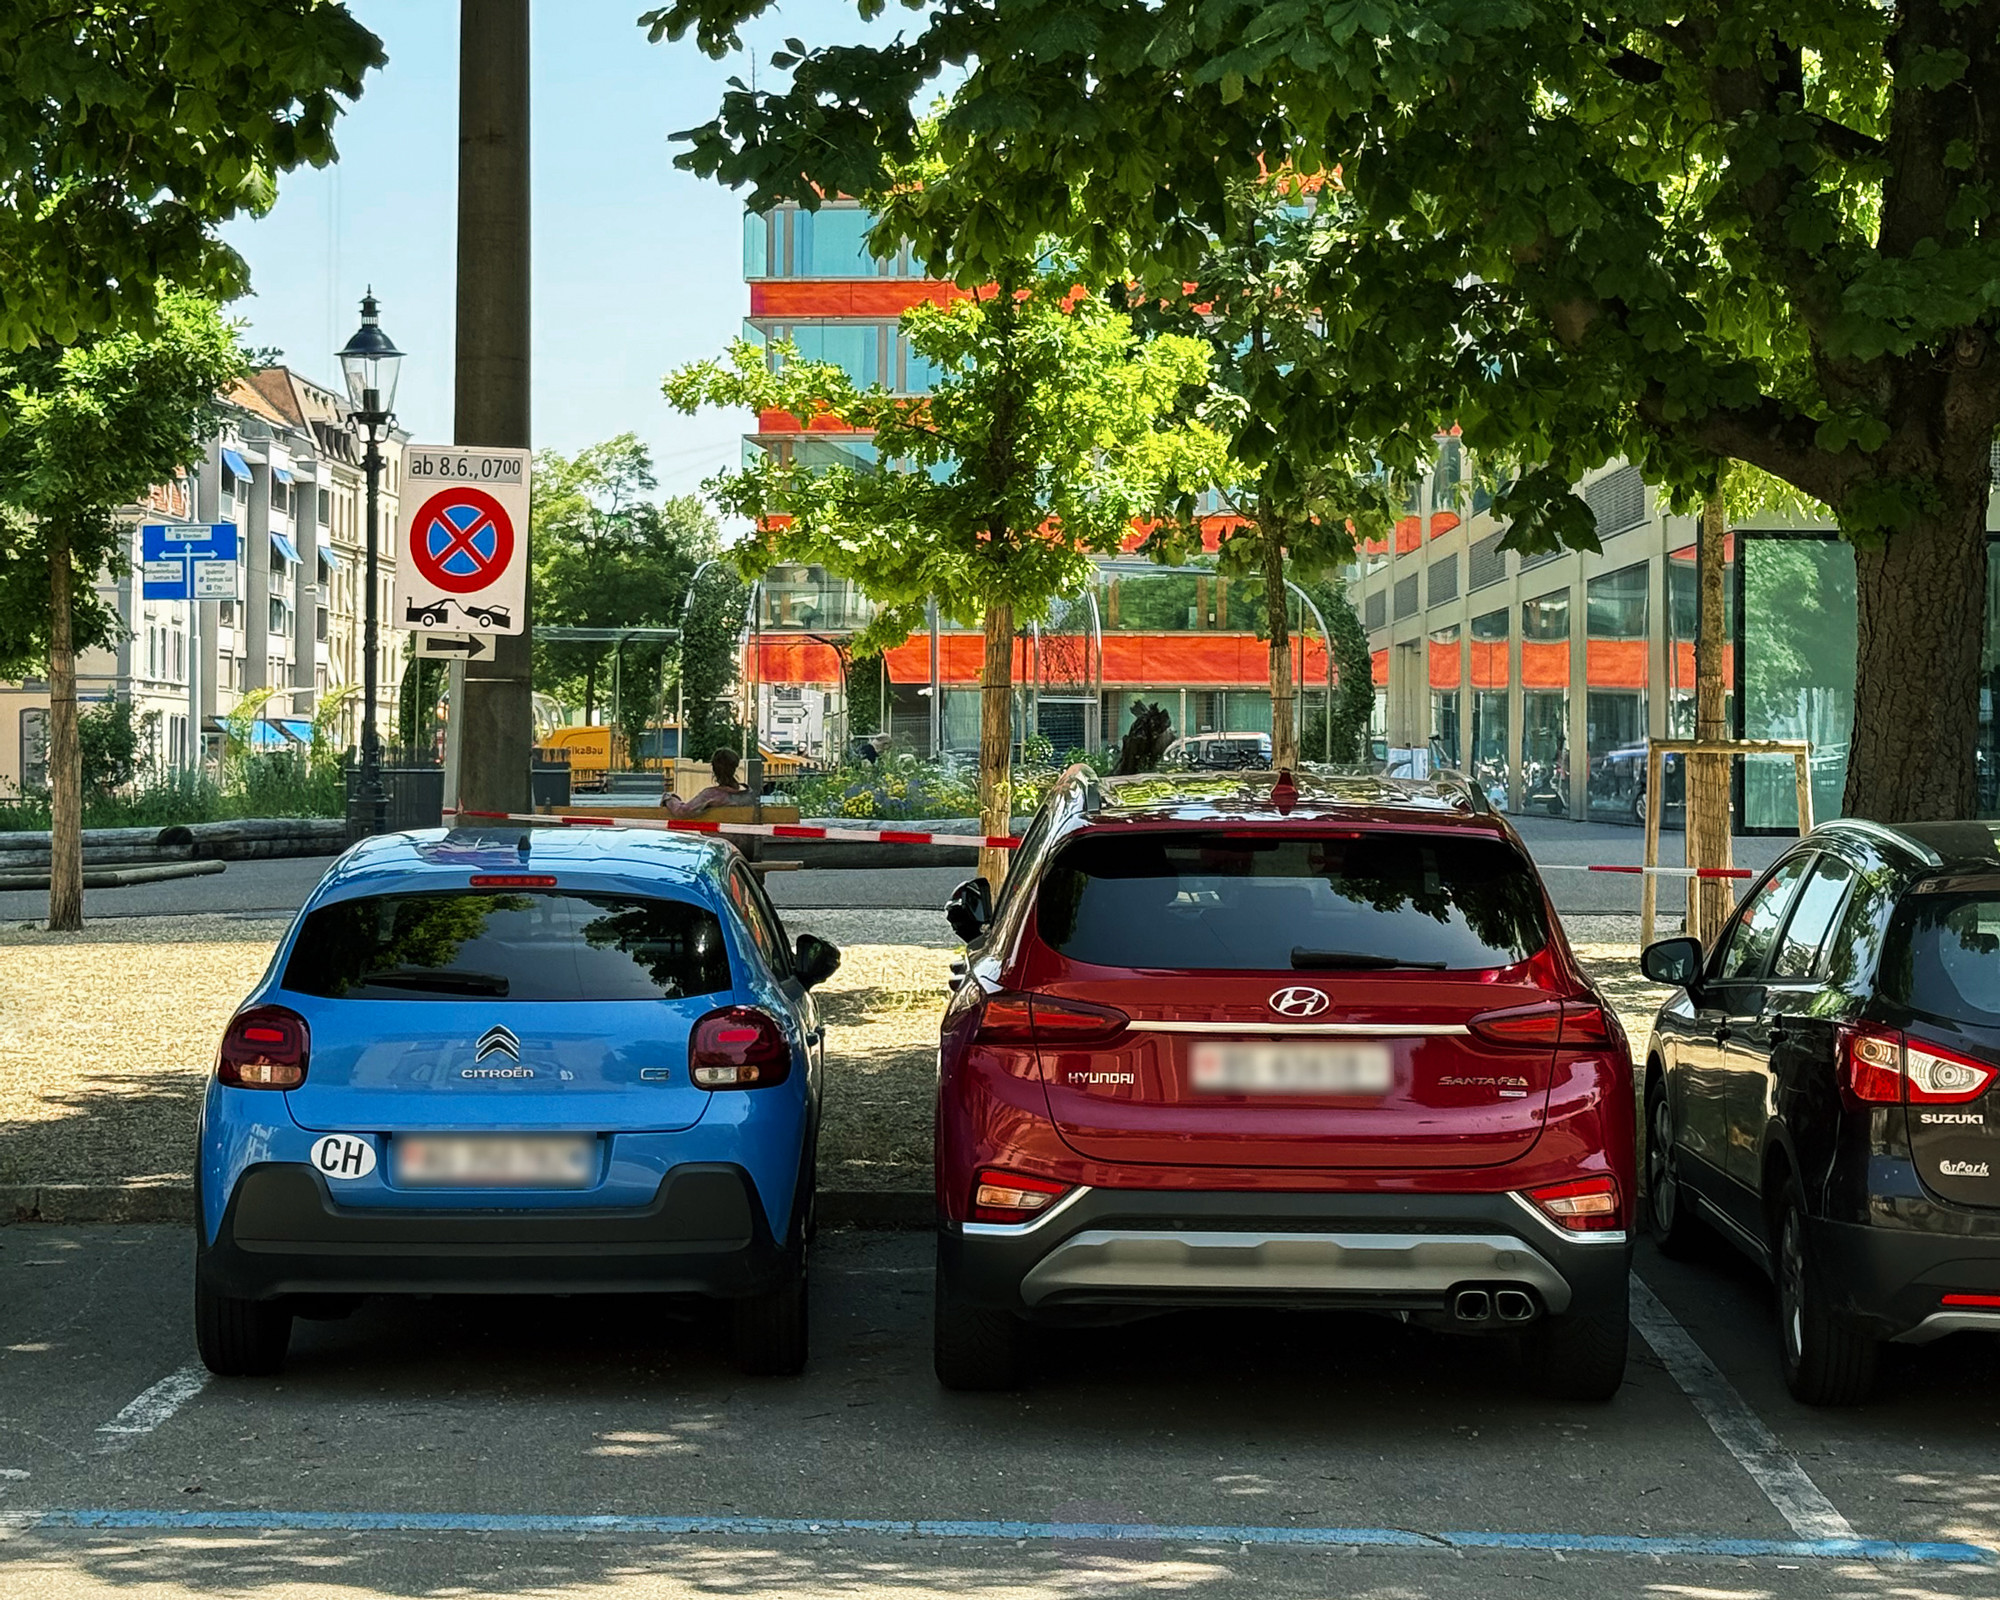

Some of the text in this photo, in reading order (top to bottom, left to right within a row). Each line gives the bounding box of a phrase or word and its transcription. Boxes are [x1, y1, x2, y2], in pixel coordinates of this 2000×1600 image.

[411, 454, 434, 476] ab
[1068, 1072, 1134, 1085] HYUNDAI
[1920, 1113, 1984, 1125] SUZUKI
[320, 1138, 364, 1176] CH
